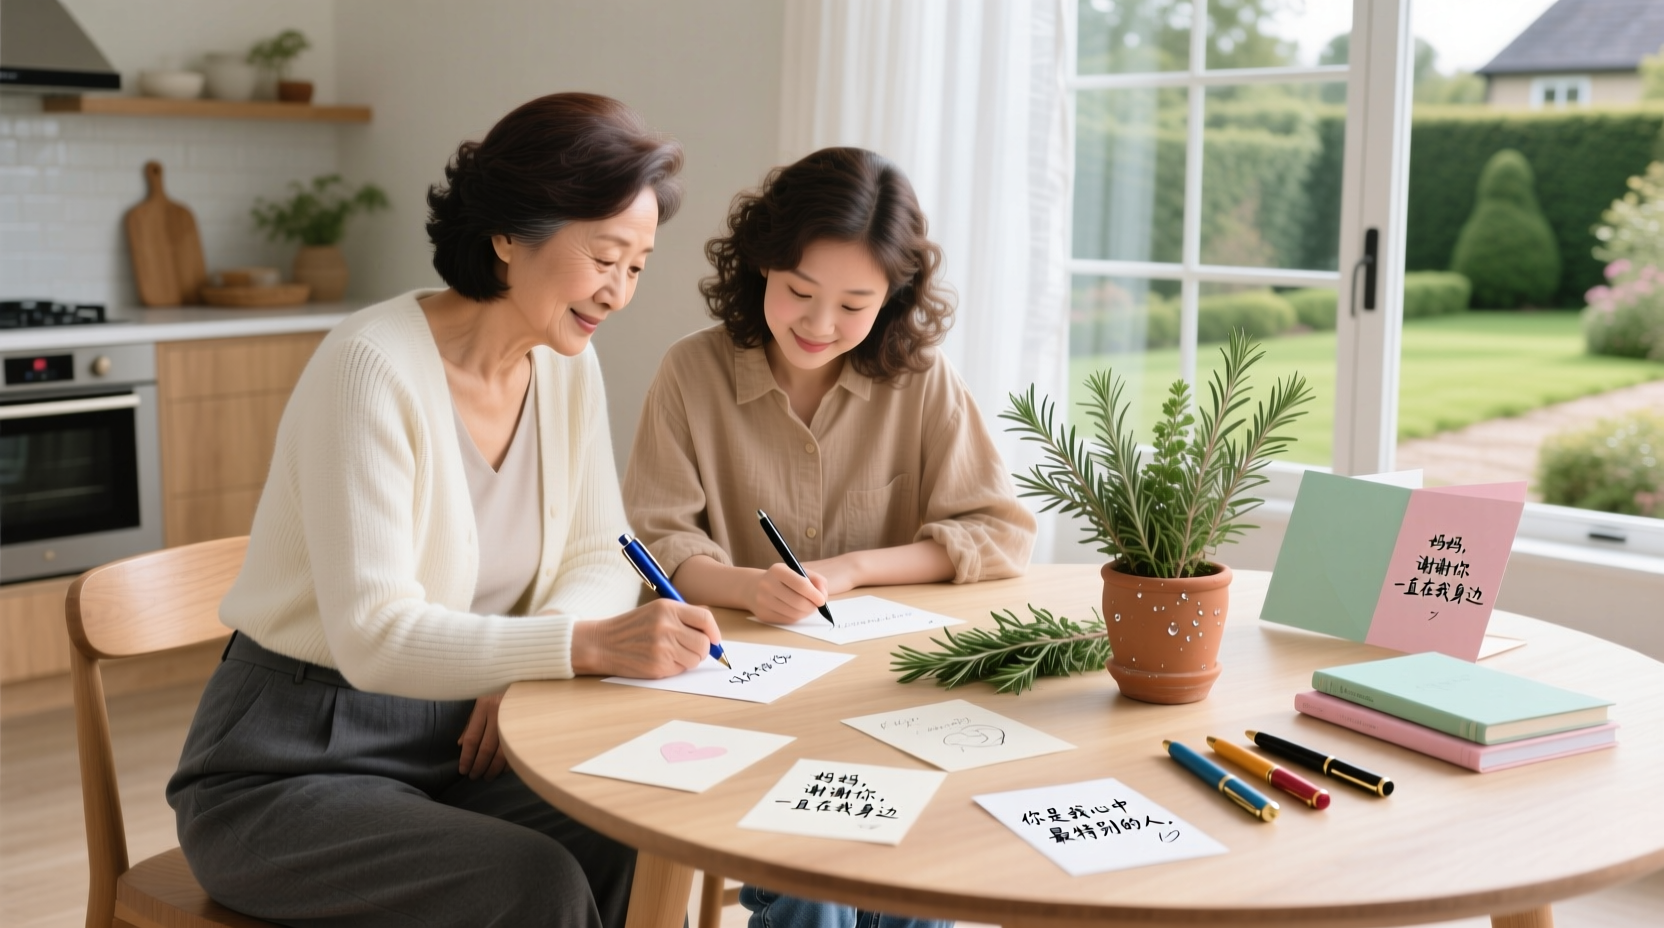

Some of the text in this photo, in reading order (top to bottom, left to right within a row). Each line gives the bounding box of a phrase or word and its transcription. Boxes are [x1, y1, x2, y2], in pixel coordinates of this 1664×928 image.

[1416, 555, 1470, 578] 谢谢你
[1394, 577, 1483, 605] 一直在我身边
[1022, 798, 1128, 826] 你是我心中
